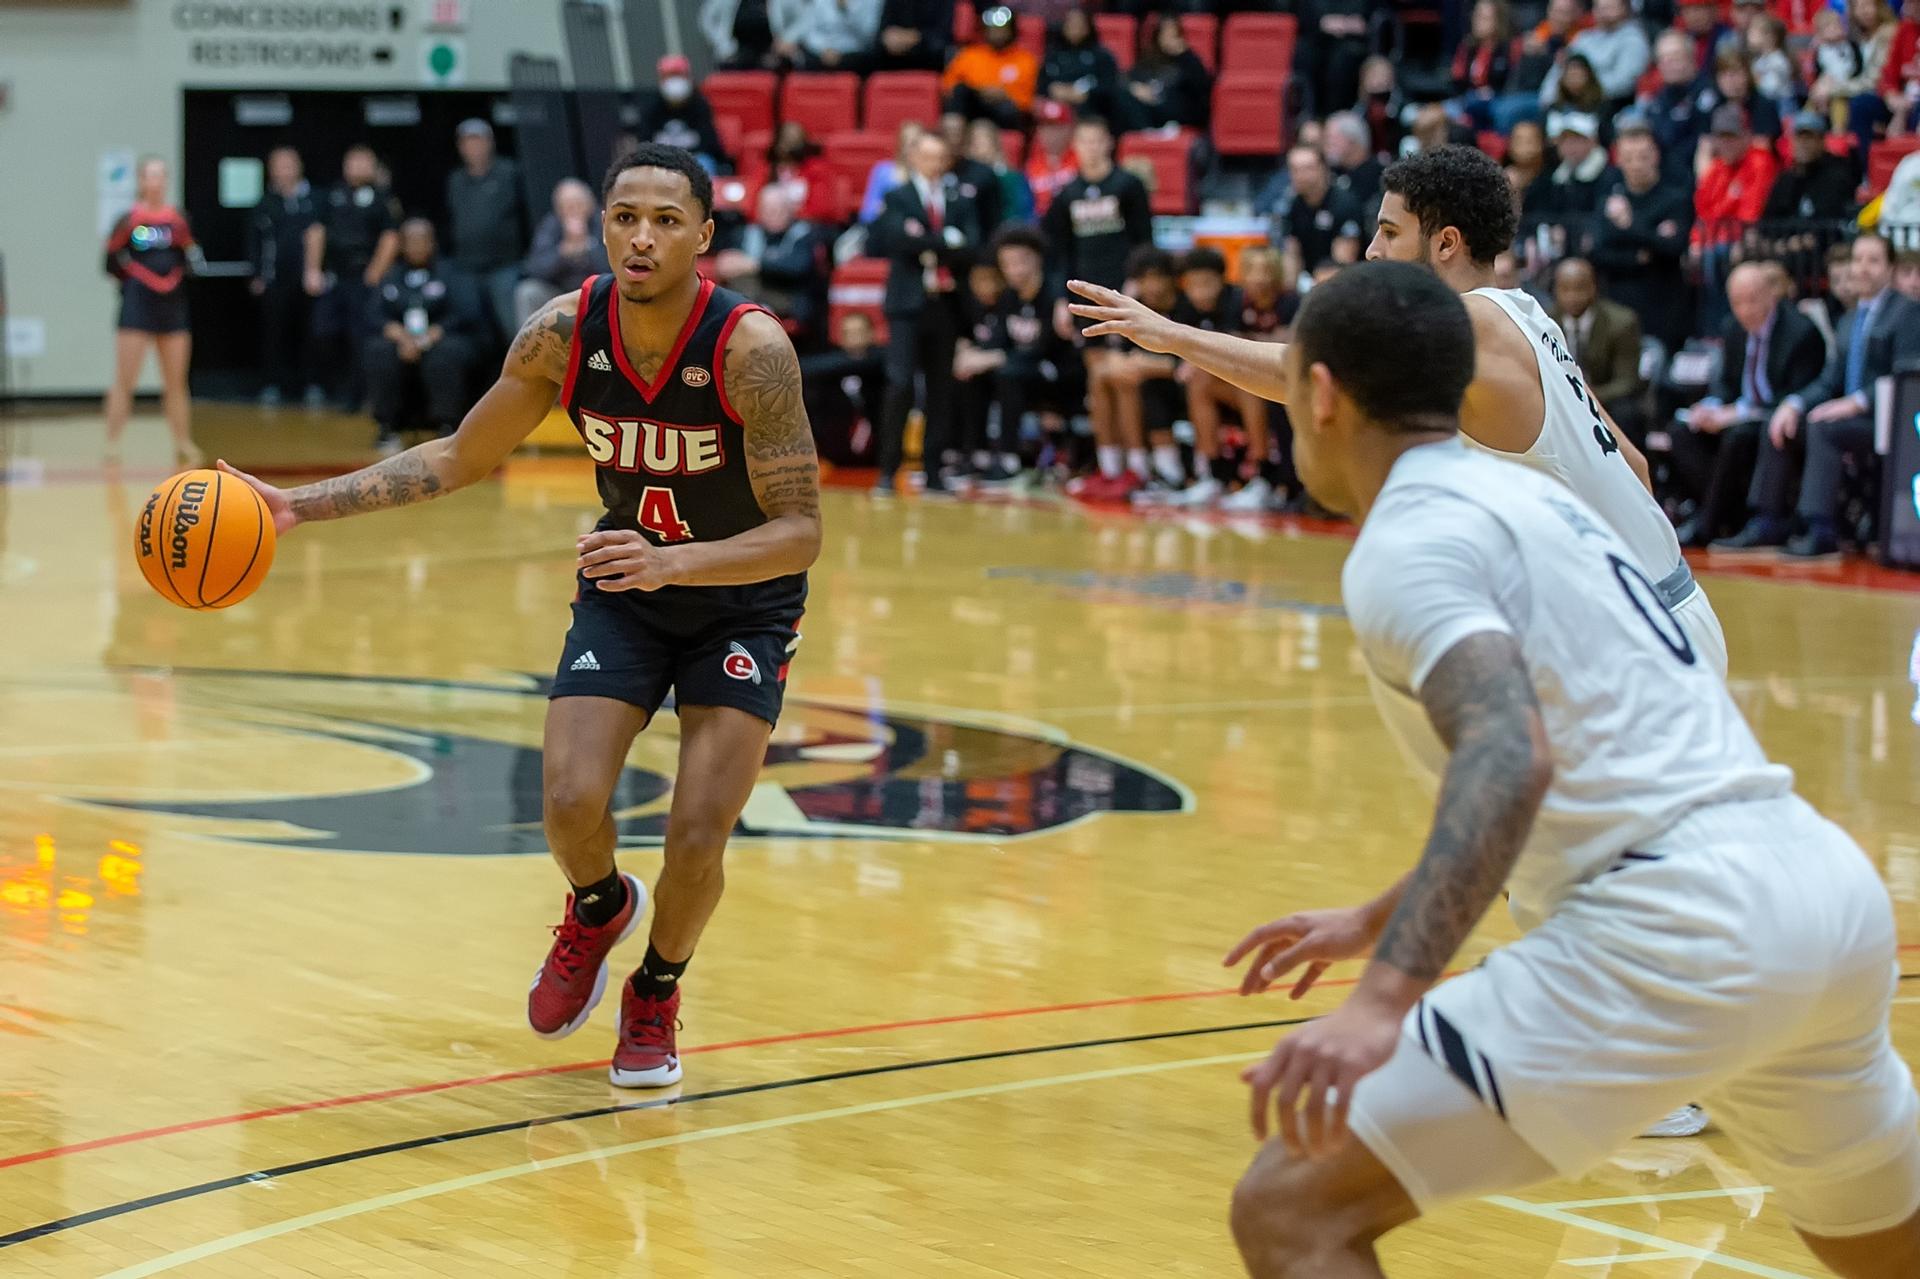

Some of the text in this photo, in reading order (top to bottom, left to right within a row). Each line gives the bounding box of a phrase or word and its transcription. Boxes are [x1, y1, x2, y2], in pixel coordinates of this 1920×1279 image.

[686, 372, 704, 381] OVC
[579, 408, 725, 476] SIUE
[140, 492, 161, 558] NCAA
[170, 481, 209, 570] Wilson
[637, 485, 694, 542] 4
[1605, 552, 1696, 666] 0
